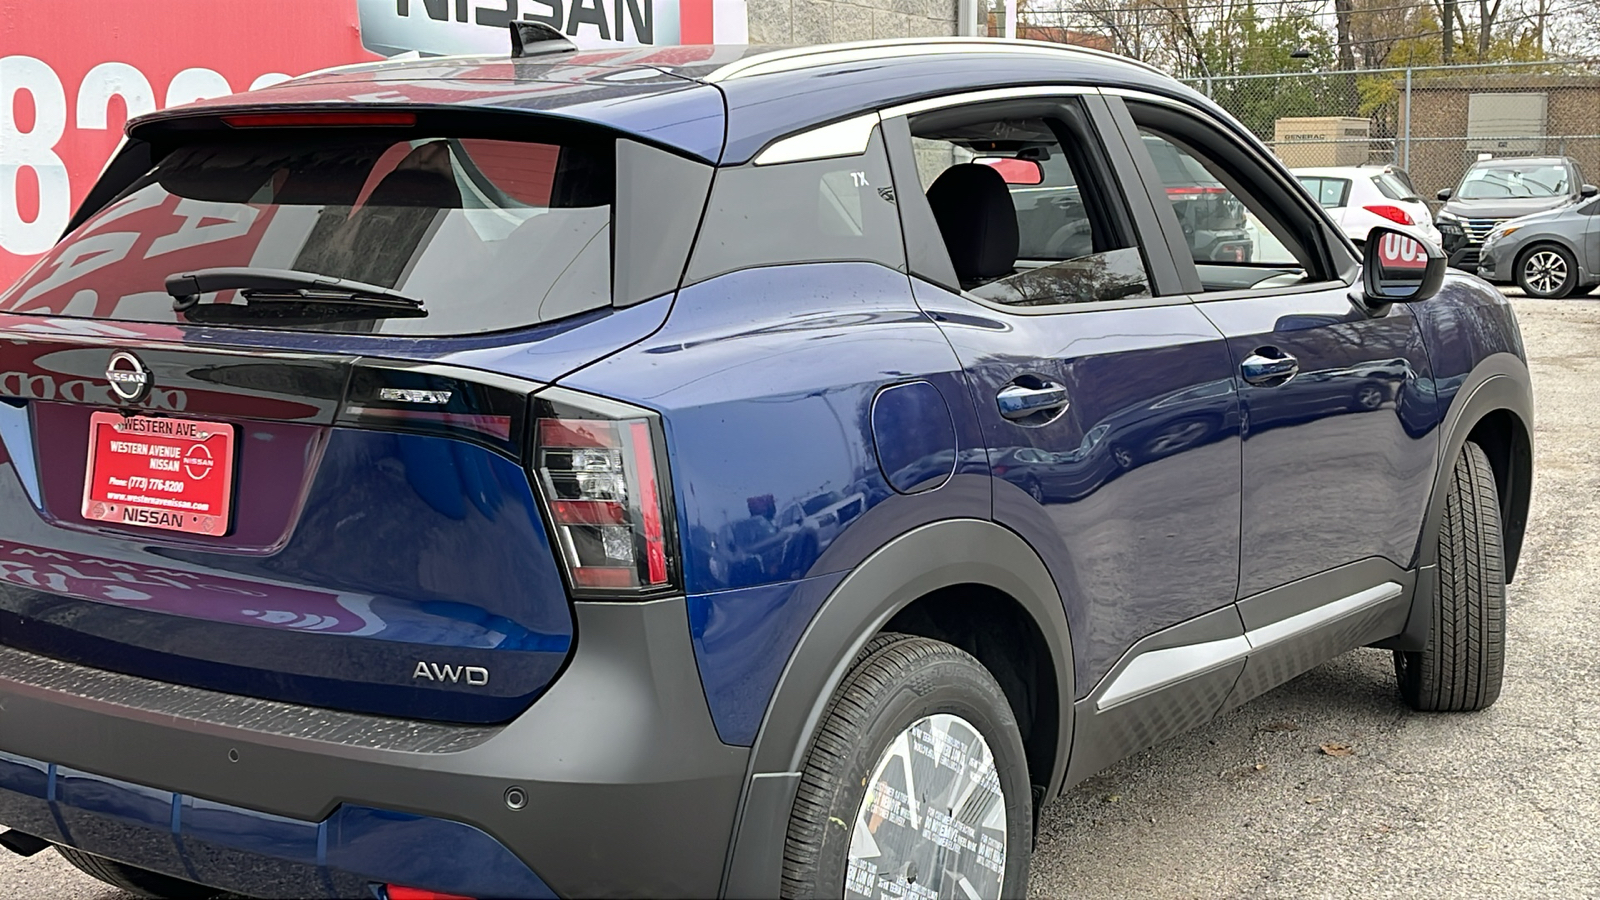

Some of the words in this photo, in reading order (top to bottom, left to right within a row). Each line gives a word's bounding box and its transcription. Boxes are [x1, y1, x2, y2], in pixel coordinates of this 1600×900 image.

[106, 372, 146, 383] NISSAN
[124, 418, 173, 434] WESTERN
[110, 440, 149, 456] WESTERN
[148, 445, 181, 458] AVENUE
[149, 458, 180, 472] NISSAN
[183, 458, 214, 467] NISSAN
[108, 476, 128, 487] Phone:
[128, 476, 148, 491] (773)
[148, 479, 185, 493] 776-8200
[107, 492, 209, 511] www.westernavenissan.com
[122, 507, 183, 528] NISSAN
[412, 661, 489, 686] AWD
